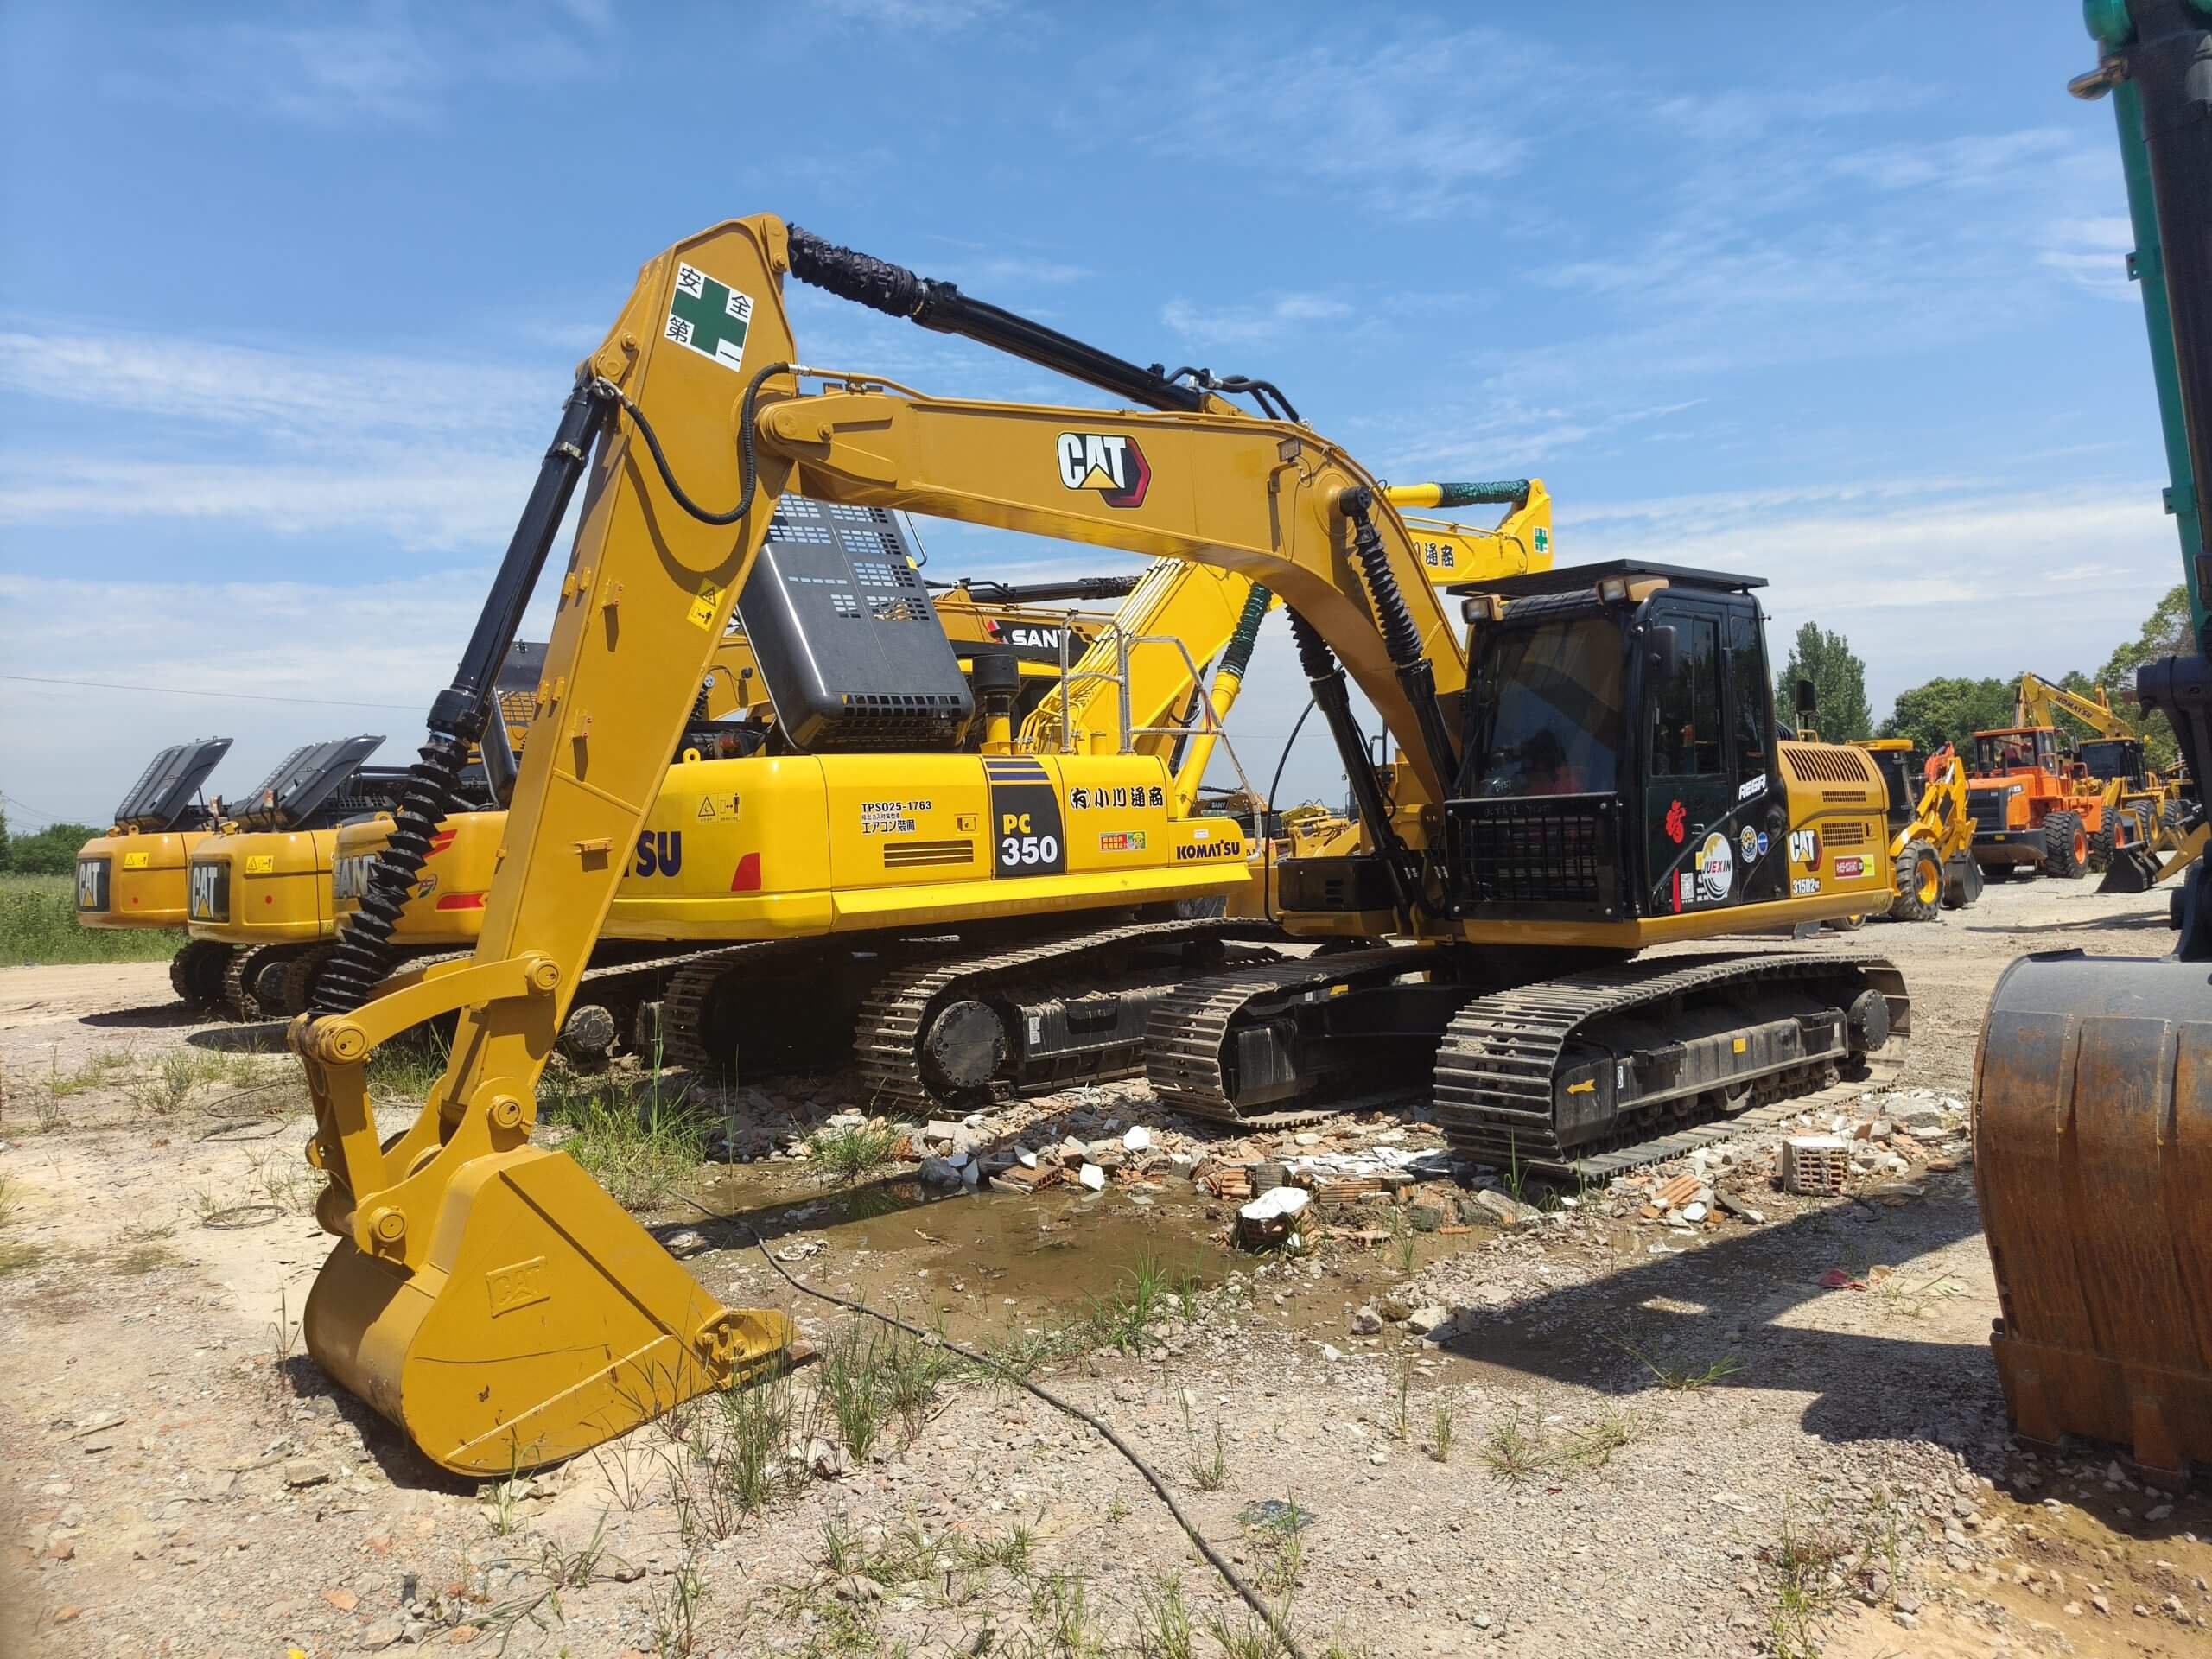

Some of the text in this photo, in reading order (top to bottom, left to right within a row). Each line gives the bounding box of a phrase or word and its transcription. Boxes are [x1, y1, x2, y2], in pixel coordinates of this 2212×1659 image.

[1057, 433, 1127, 489] CAT
[2056, 694, 2094, 719] KOMATSU
[862, 819, 915, 834] エアコン装備
[1002, 813, 1031, 835] PC
[624, 830, 682, 877] SU
[1001, 836, 1058, 866] 350
[1176, 839, 1240, 860] KOMATSU
[1789, 830, 1815, 862] CAT
[1703, 859, 1732, 874] JUEXIN
[79, 862, 99, 906] CAT
[193, 866, 218, 918] CAT
